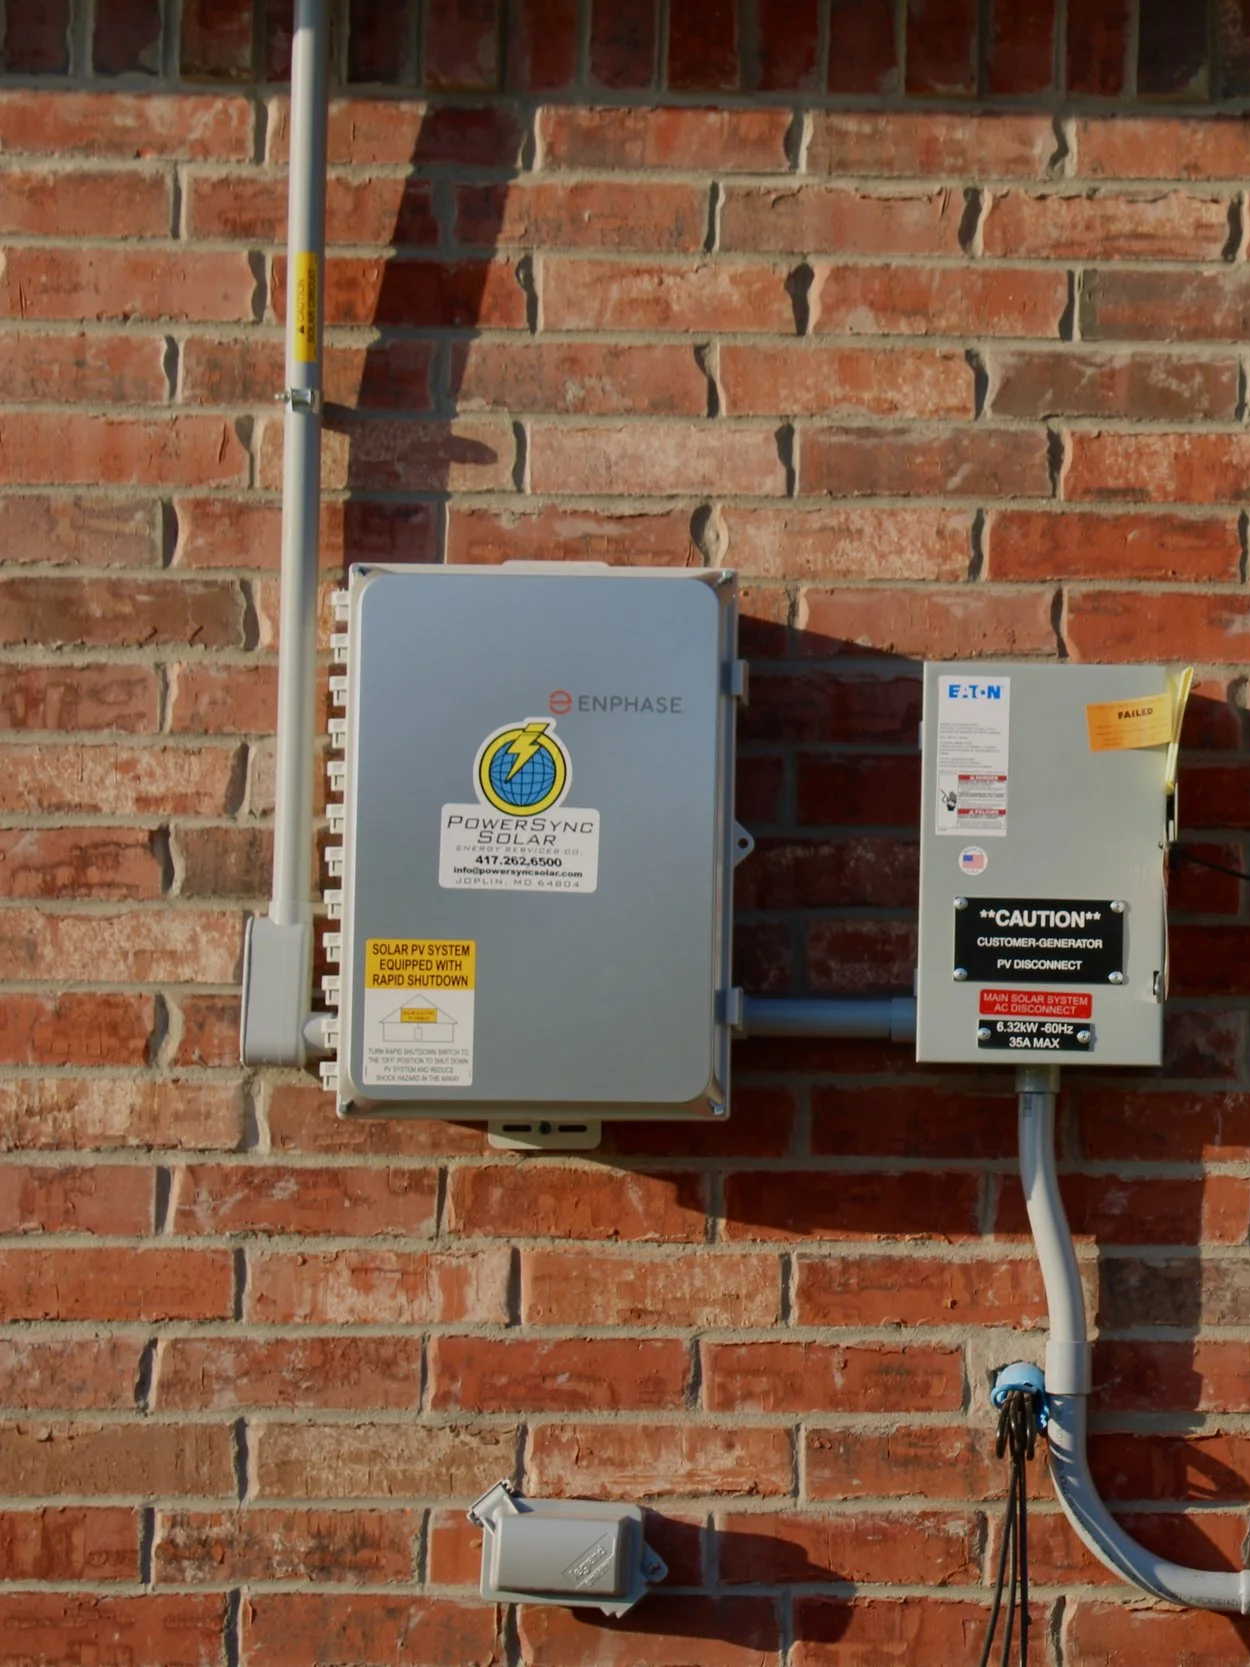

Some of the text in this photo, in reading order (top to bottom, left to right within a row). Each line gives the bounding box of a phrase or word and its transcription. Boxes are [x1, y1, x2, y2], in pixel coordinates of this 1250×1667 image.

[578, 695, 683, 714] ENPHASE
[1118, 708, 1153, 720] FAILED
[477, 829, 557, 846] SOLAR
[475, 855, 562, 867] 417.262.6500
[454, 867, 583, 878] info@powersyncsolar.com
[977, 937, 1103, 949] CUSTOMER-GENERATOR
[372, 943, 470, 956] SOLAR PV SYSTEM
[379, 959, 462, 972] EQUIPPED WITH
[997, 959, 1083, 970] PV DISCONNECT
[372, 974, 468, 987] RAPID SHUTDOWN
[983, 992, 1089, 1006] MAIN SOLAR SYSTEM
[994, 1003, 1077, 1015] AC DISCONNECT
[996, 1021, 1039, 1033] 6.32kW
[1009, 1037, 1060, 1048] 35A MAX
